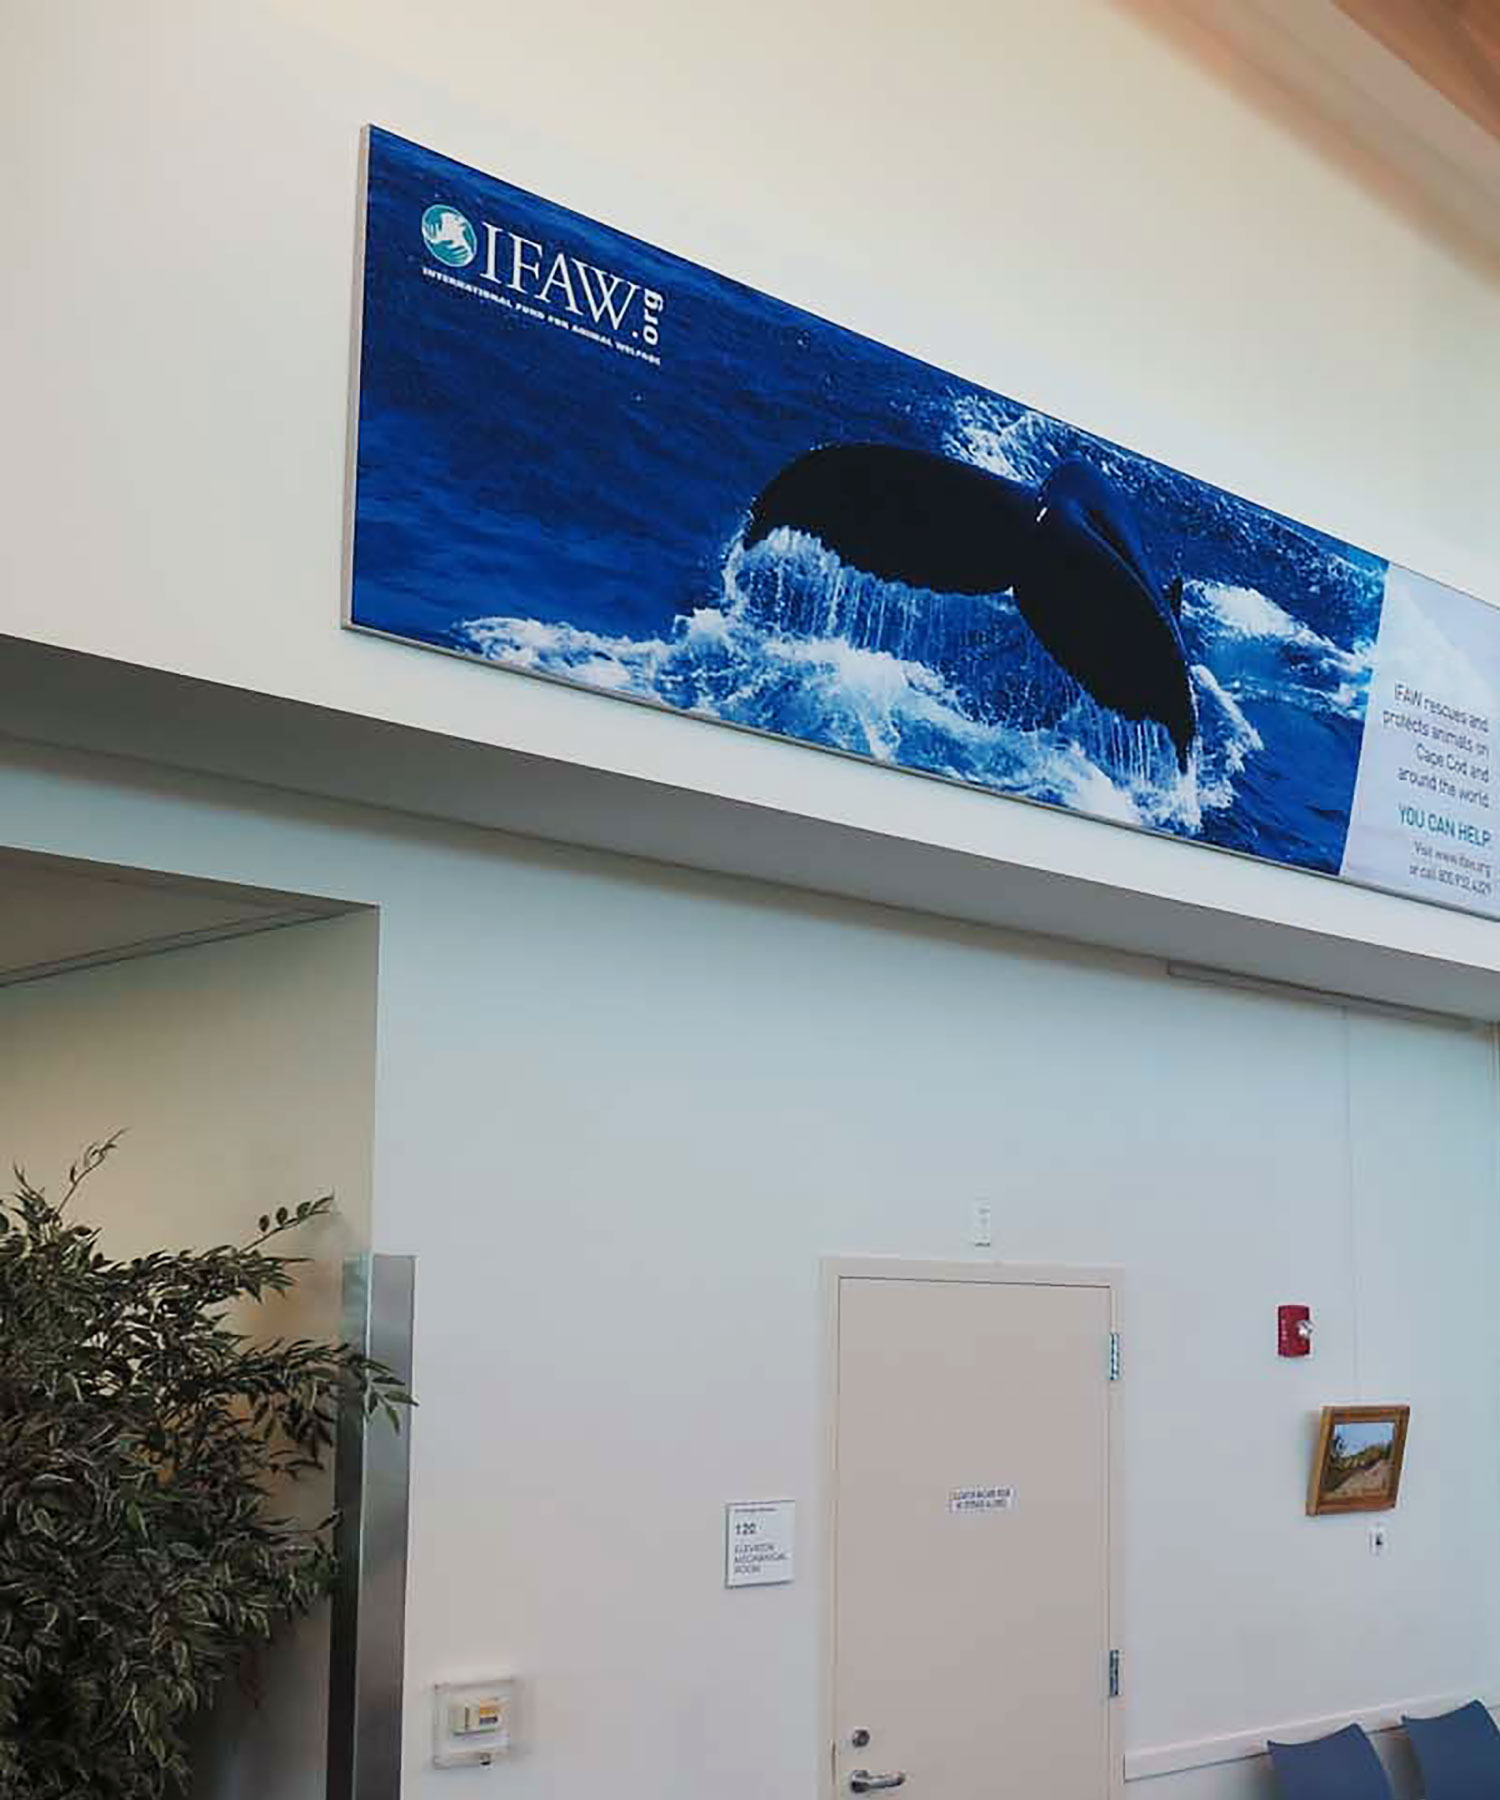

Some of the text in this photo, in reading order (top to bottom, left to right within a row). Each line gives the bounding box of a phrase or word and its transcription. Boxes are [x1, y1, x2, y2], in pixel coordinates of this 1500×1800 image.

[422, 266, 662, 367] INTERNATIONAL FUND FOR ANIMAL WELFARE
[1416, 742, 1490, 783] Cape Cod and
[1398, 803, 1425, 828] YOU
[1427, 813, 1456, 838] CAN
